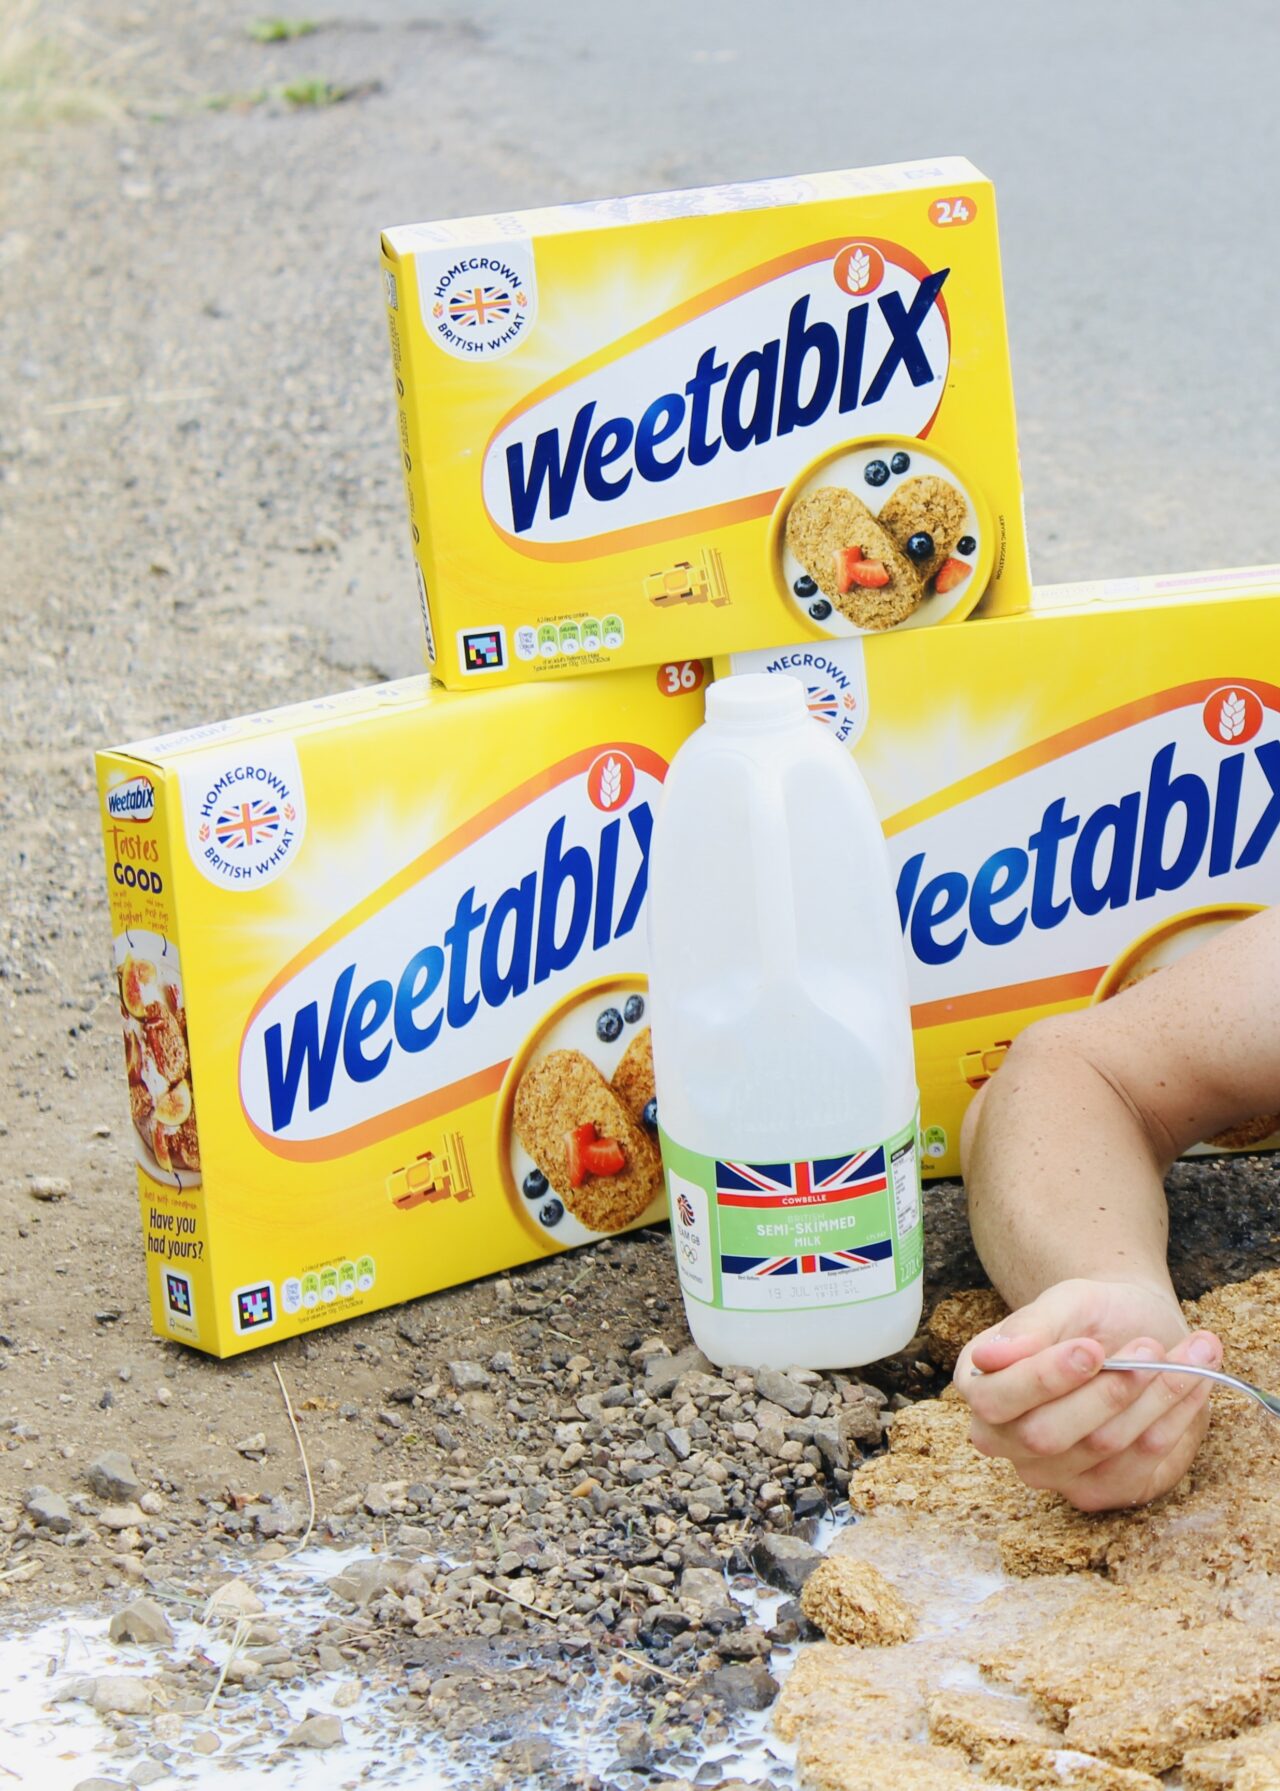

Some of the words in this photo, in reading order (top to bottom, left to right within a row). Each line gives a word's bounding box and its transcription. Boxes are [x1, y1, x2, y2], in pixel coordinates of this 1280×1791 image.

[936, 199, 969, 224] 24
[434, 258, 522, 298] HOMEGROWN
[438, 323, 483, 352] BRITISH
[487, 312, 526, 350] WHEAT
[506, 268, 950, 533] Weetabix
[665, 661, 696, 693] 36
[766, 653, 851, 689] MEGROWN
[835, 716, 854, 742] EAT
[108, 786, 155, 813] Weetabix
[200, 766, 290, 818] HOMEGROWN
[107, 825, 159, 863] Tastes
[204, 847, 252, 878] BRITISH
[255, 828, 294, 874] WHEAT
[113, 862, 163, 894] GOOD
[782, 1194, 827, 1205] COWBELLE
[150, 1208, 174, 1231] Have
[176, 1216, 196, 1236] you
[756, 1215, 856, 1236] SEMI-SKIMMED
[148, 1232, 165, 1254] had
[167, 1240, 204, 1260] yours?
[794, 1236, 821, 1248] MILK
